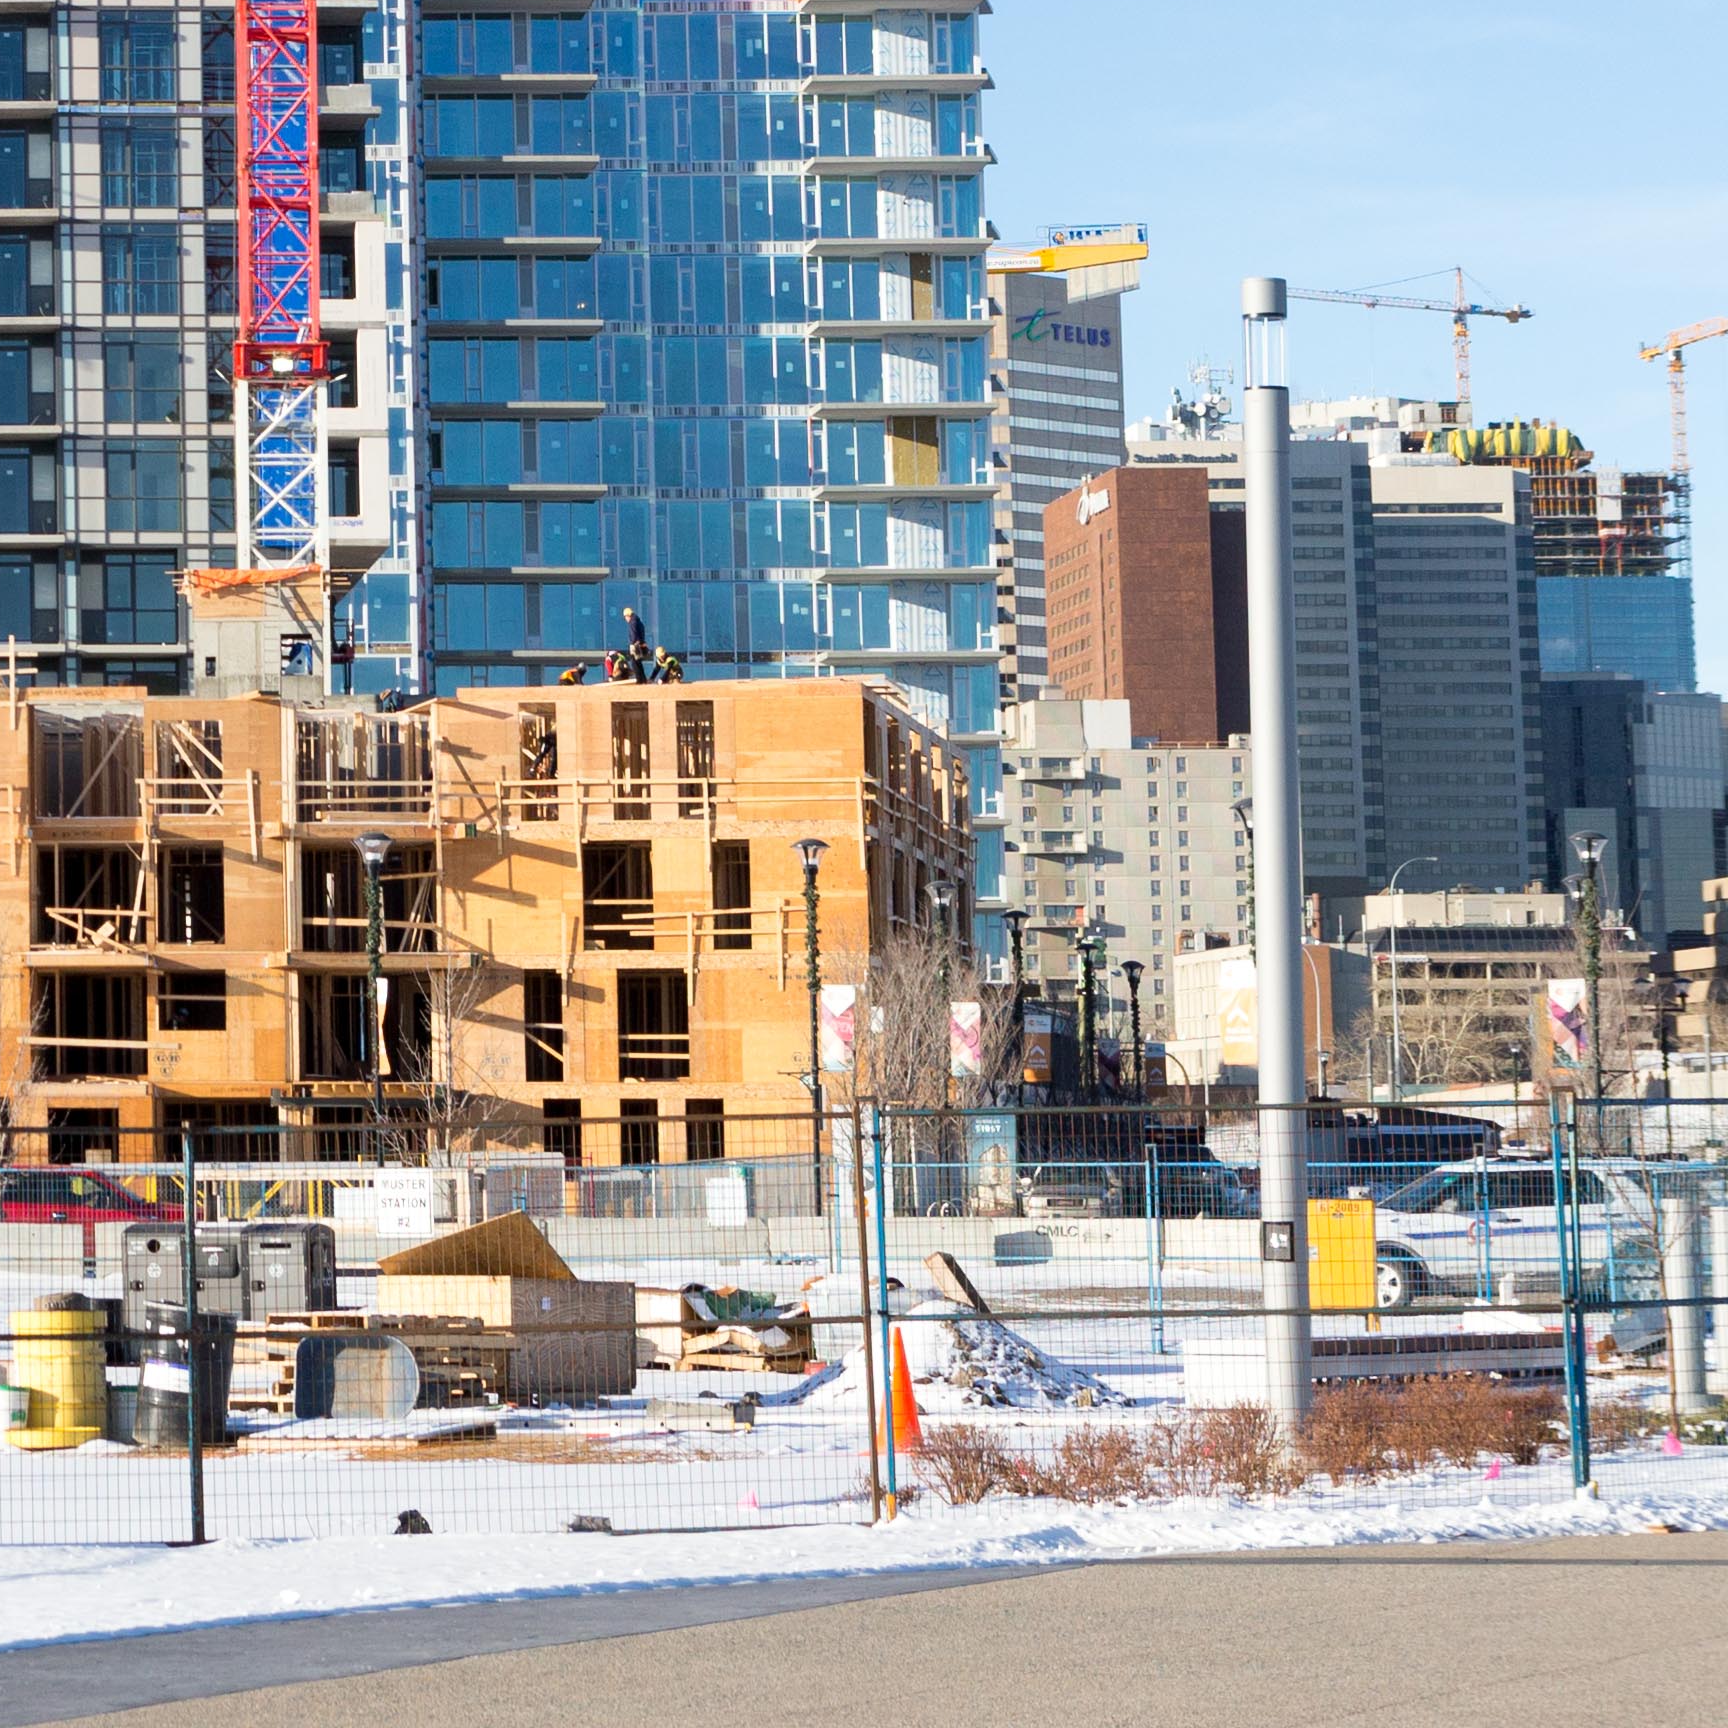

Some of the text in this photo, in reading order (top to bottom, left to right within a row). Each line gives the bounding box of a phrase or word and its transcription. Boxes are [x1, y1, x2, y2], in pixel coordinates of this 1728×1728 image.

[1051, 323, 1112, 348] TELUS
[382, 1179, 426, 1190] MUSTER
[381, 1198, 426, 1208] STATION
[398, 1217, 410, 1228] #2
[1035, 1225, 1079, 1237] CMLC
